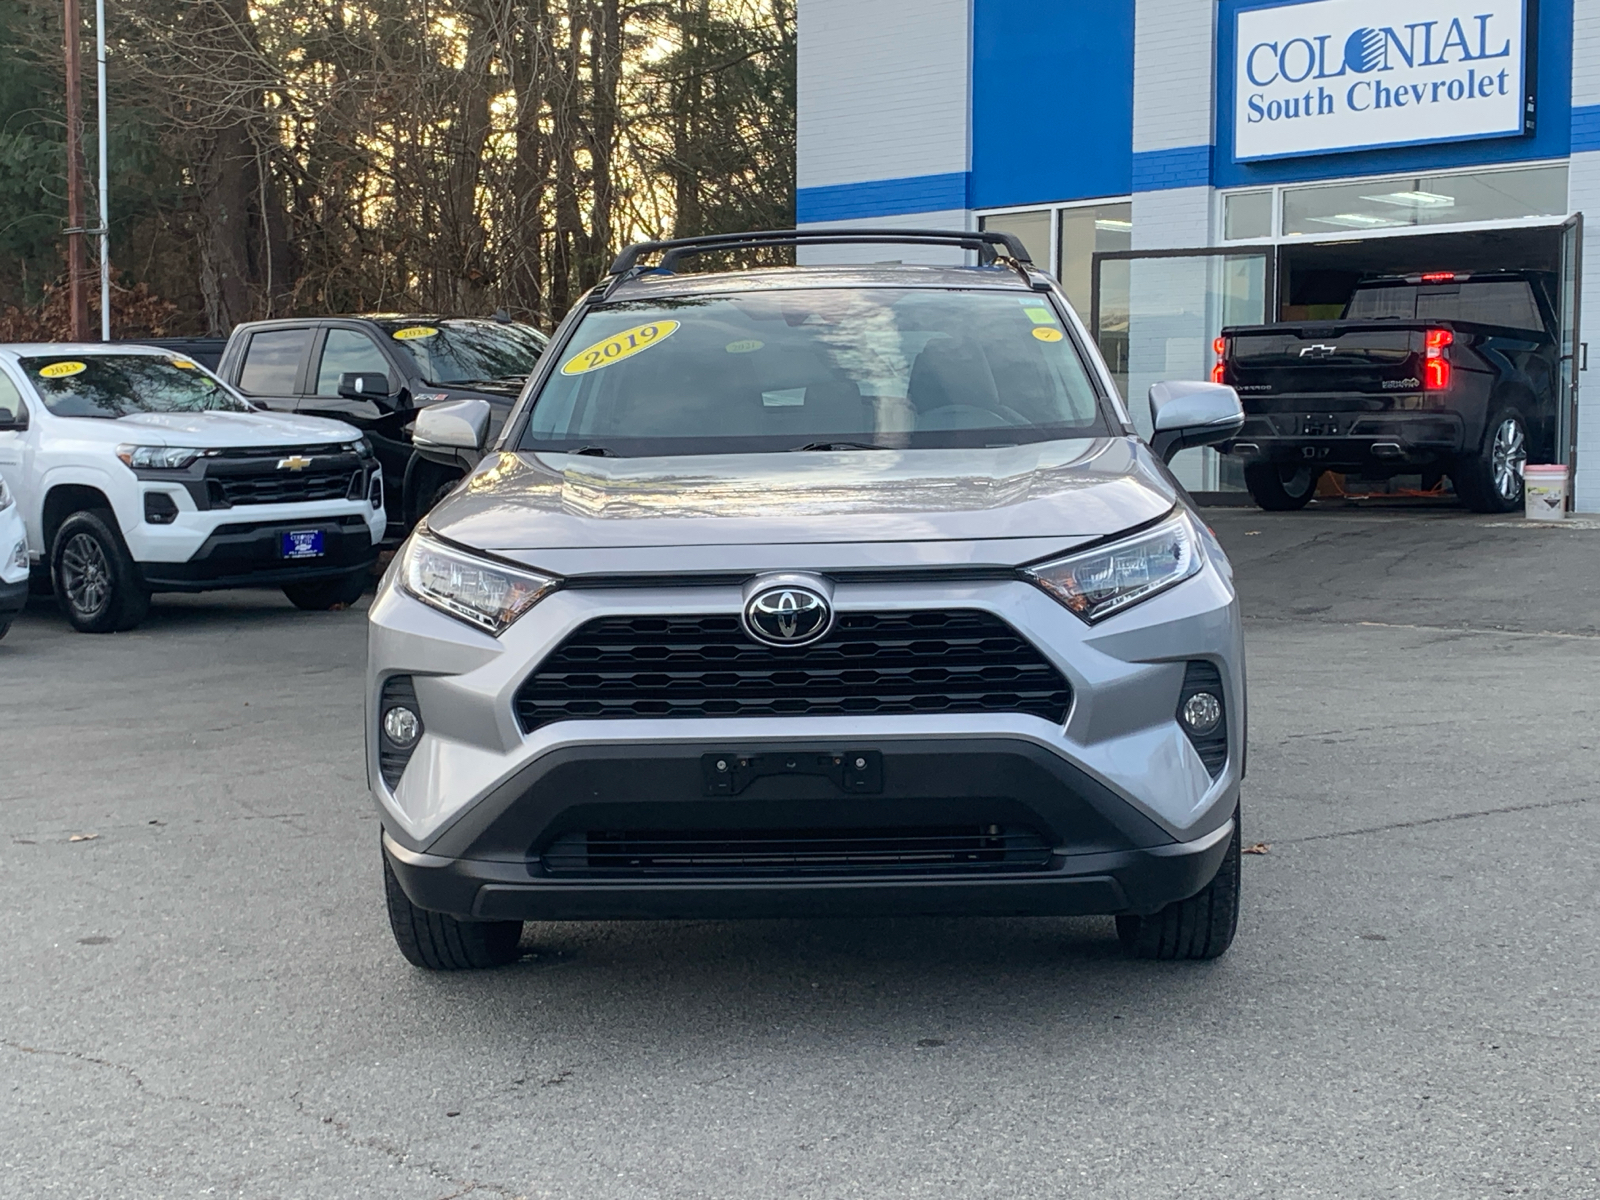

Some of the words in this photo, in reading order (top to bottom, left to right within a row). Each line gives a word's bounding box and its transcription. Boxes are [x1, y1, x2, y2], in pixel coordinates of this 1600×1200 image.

[1246, 13, 1511, 87] COLONIAL
[1247, 86, 1334, 124] South
[1346, 67, 1510, 112] Chevrolet
[50, 363, 78, 376] 2023
[584, 325, 660, 369] 2019
